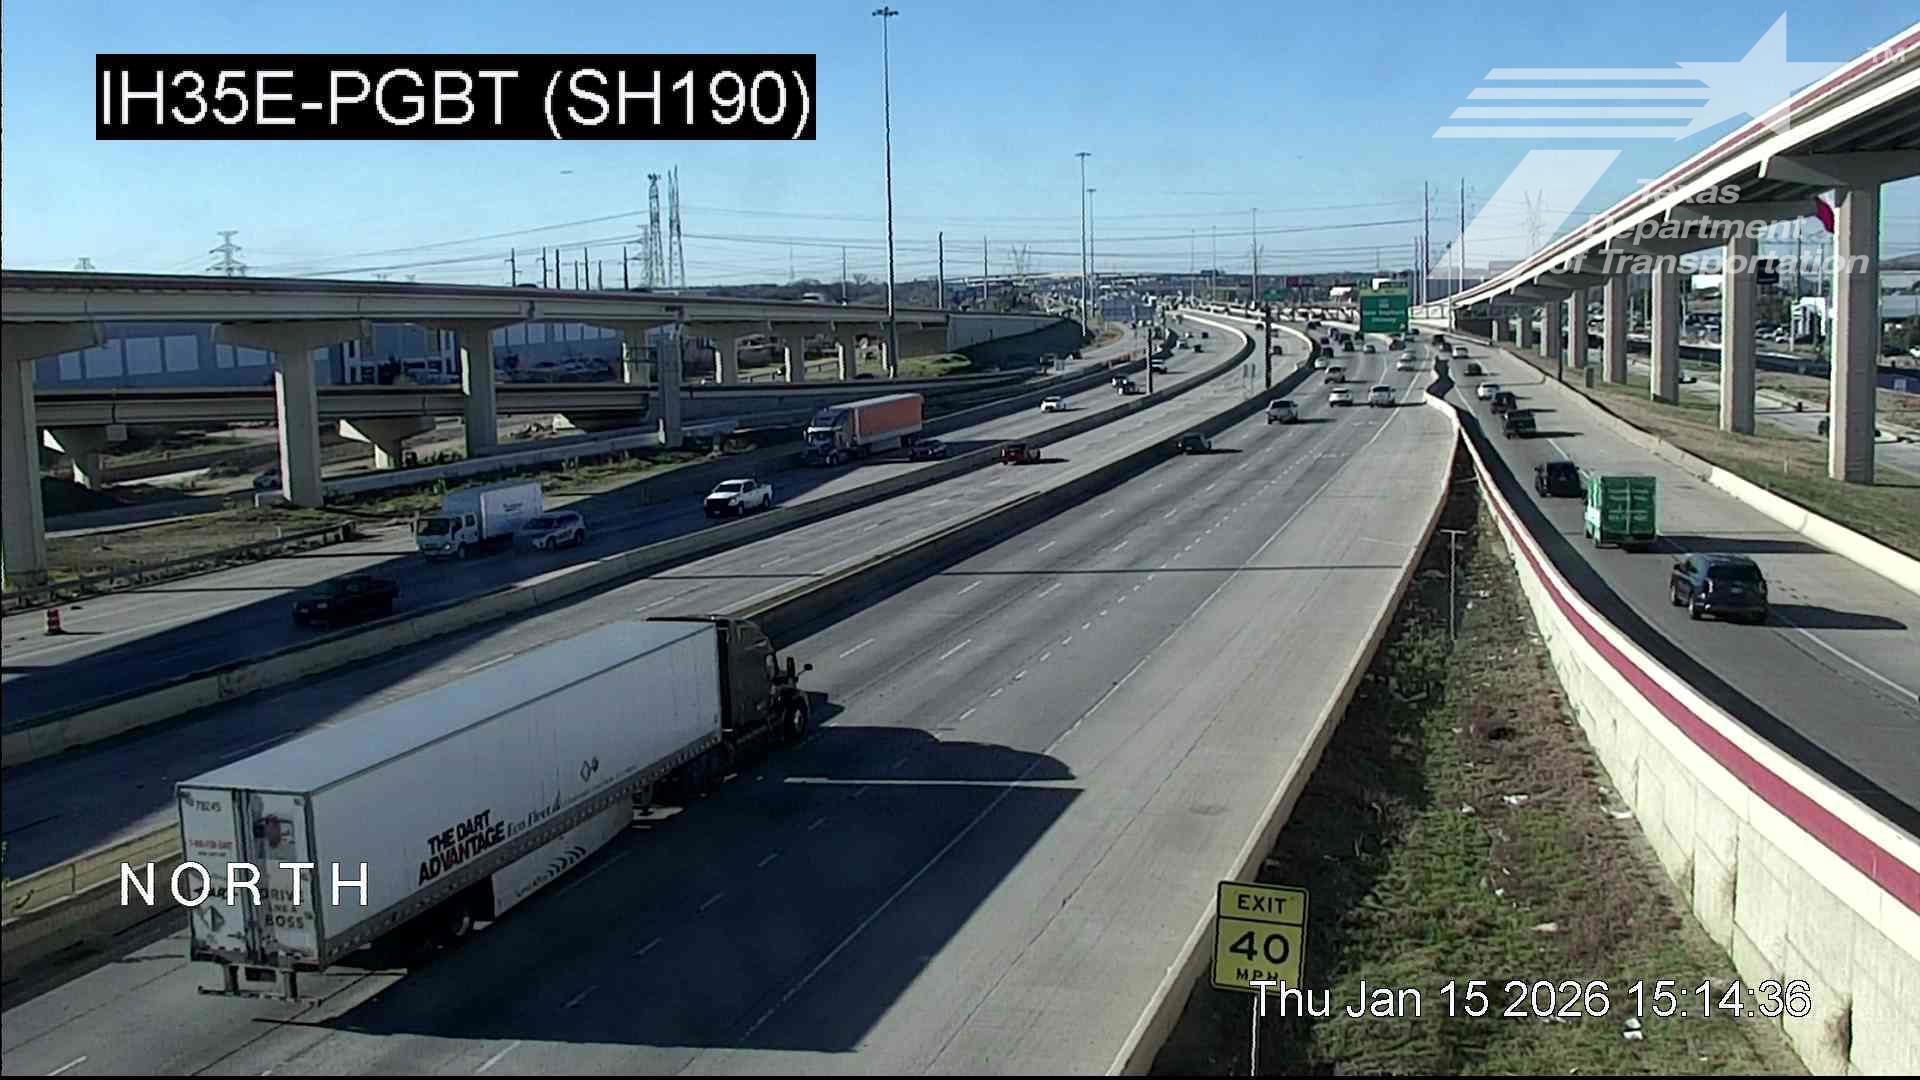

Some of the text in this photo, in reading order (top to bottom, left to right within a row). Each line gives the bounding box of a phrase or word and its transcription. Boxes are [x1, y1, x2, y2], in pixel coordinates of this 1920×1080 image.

[427, 809, 491, 857] THE DART
[418, 820, 506, 886] ADVANTAGE
[261, 887, 304, 904] DRIV
[1237, 894, 1287, 914] EXIT
[265, 914, 305, 929] BOSS
[1229, 931, 1290, 964] 40
[1236, 967, 1279, 982] MPH
